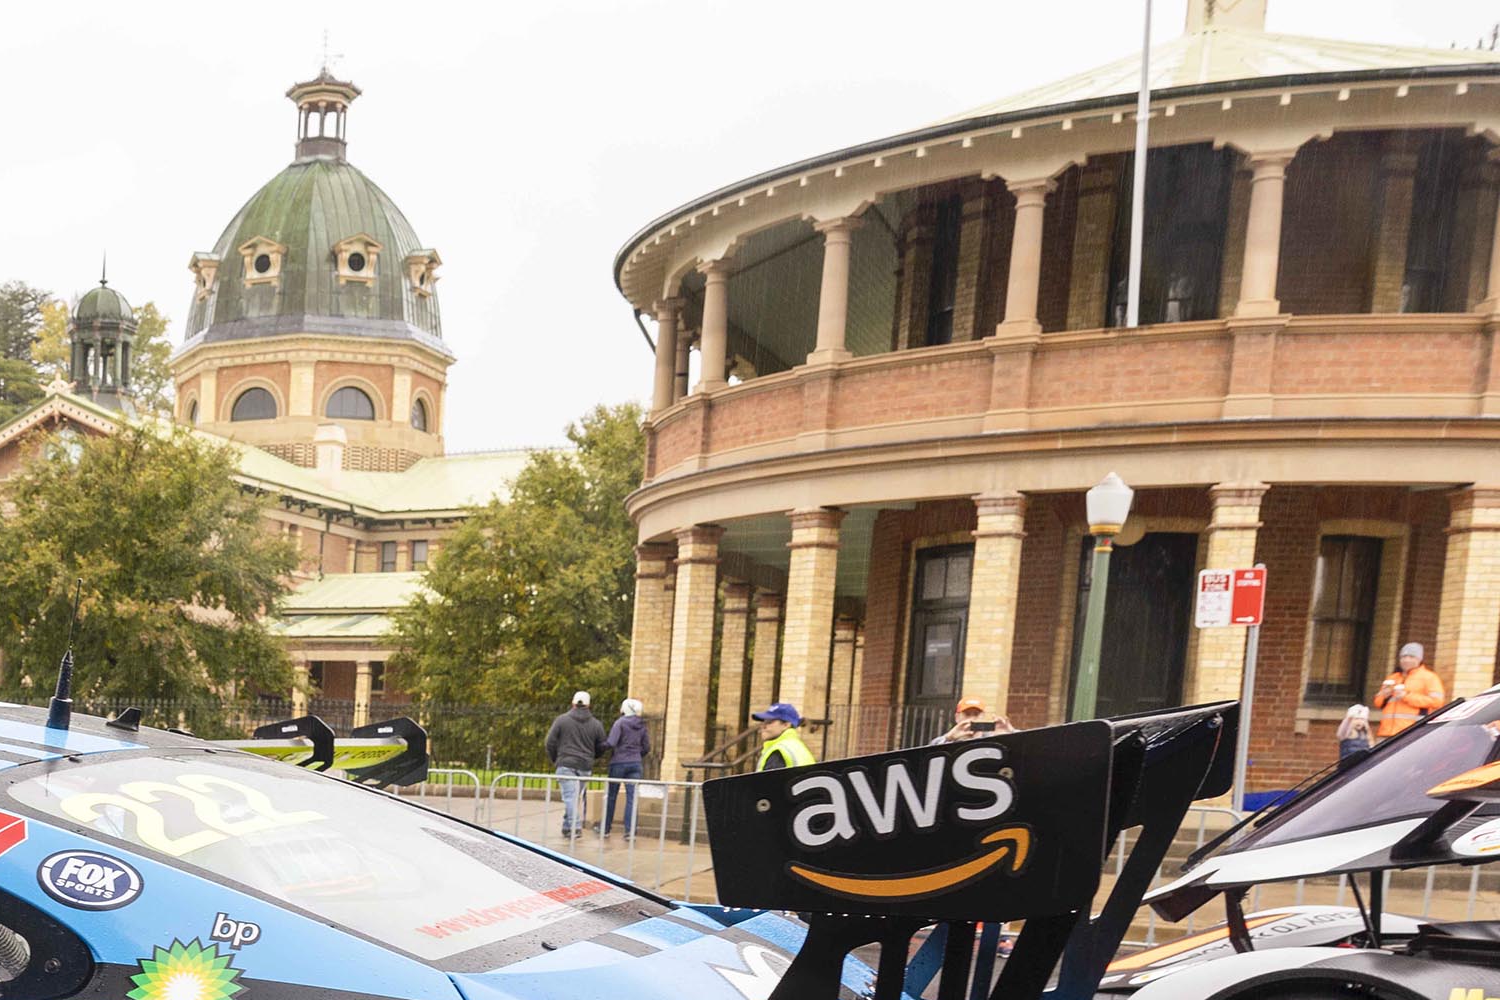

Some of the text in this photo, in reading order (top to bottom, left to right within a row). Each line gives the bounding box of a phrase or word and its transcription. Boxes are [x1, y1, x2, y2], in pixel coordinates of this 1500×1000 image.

[791, 747, 1014, 847] aws
[60, 774, 329, 857] 222
[55, 877, 114, 900] SPORTS
[58, 857, 125, 893] FOX
[211, 913, 260, 948] bp
